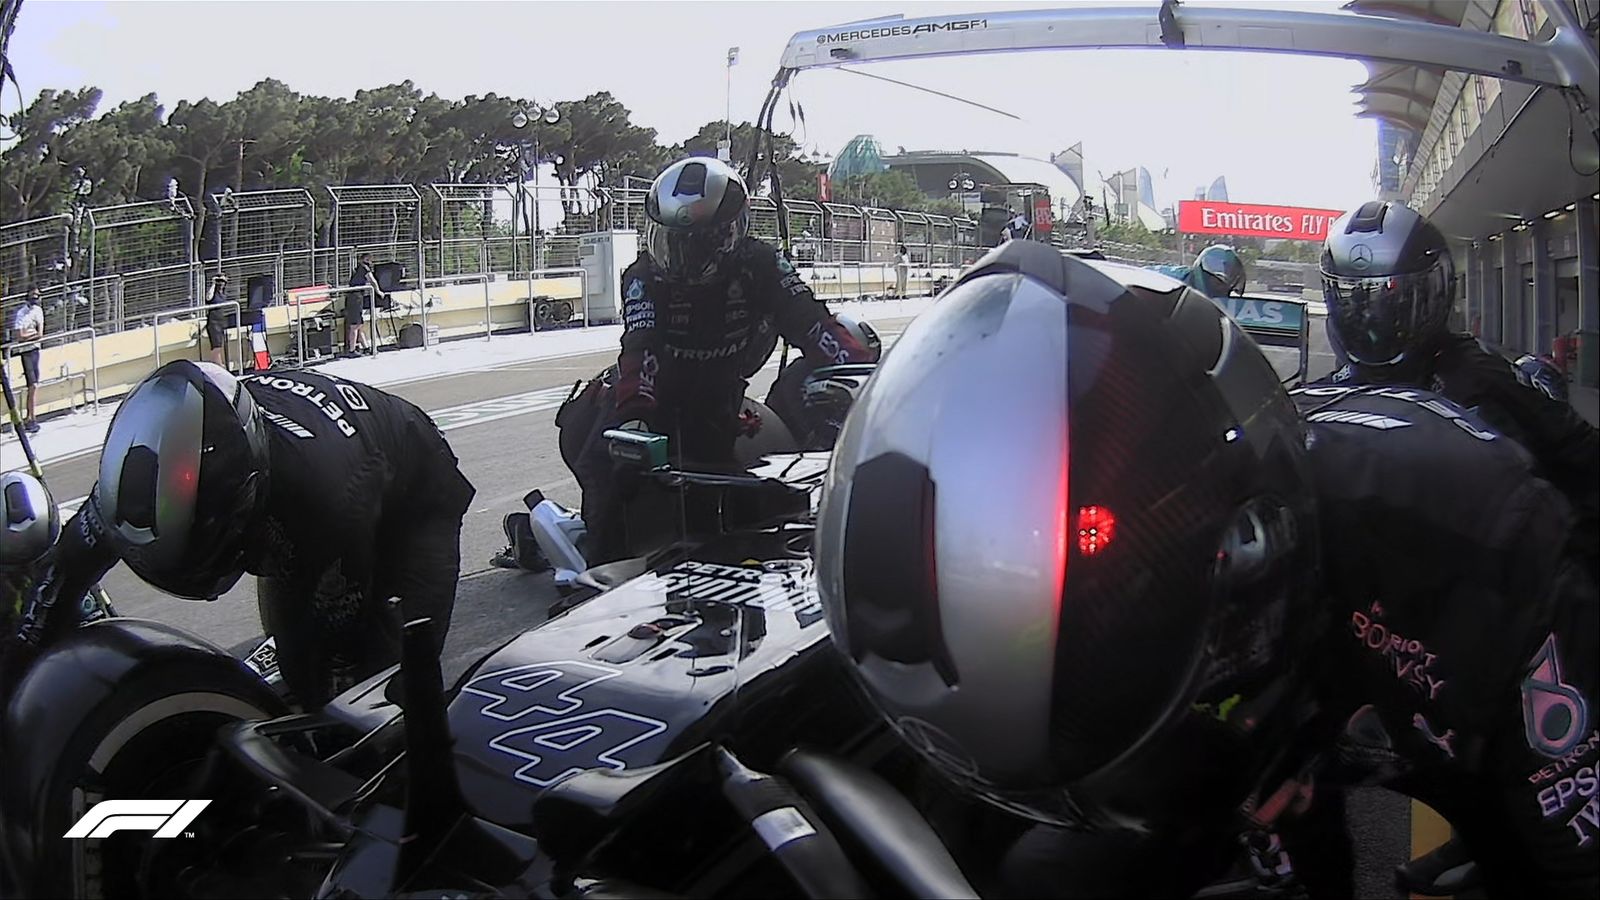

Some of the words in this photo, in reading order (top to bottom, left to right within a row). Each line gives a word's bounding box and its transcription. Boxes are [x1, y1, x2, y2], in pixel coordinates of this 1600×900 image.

[1201, 207, 1294, 233] Emirates
[1301, 214, 1325, 235] FLY
[461, 660, 668, 788] 44
[1537, 760, 1600, 818] EPS
